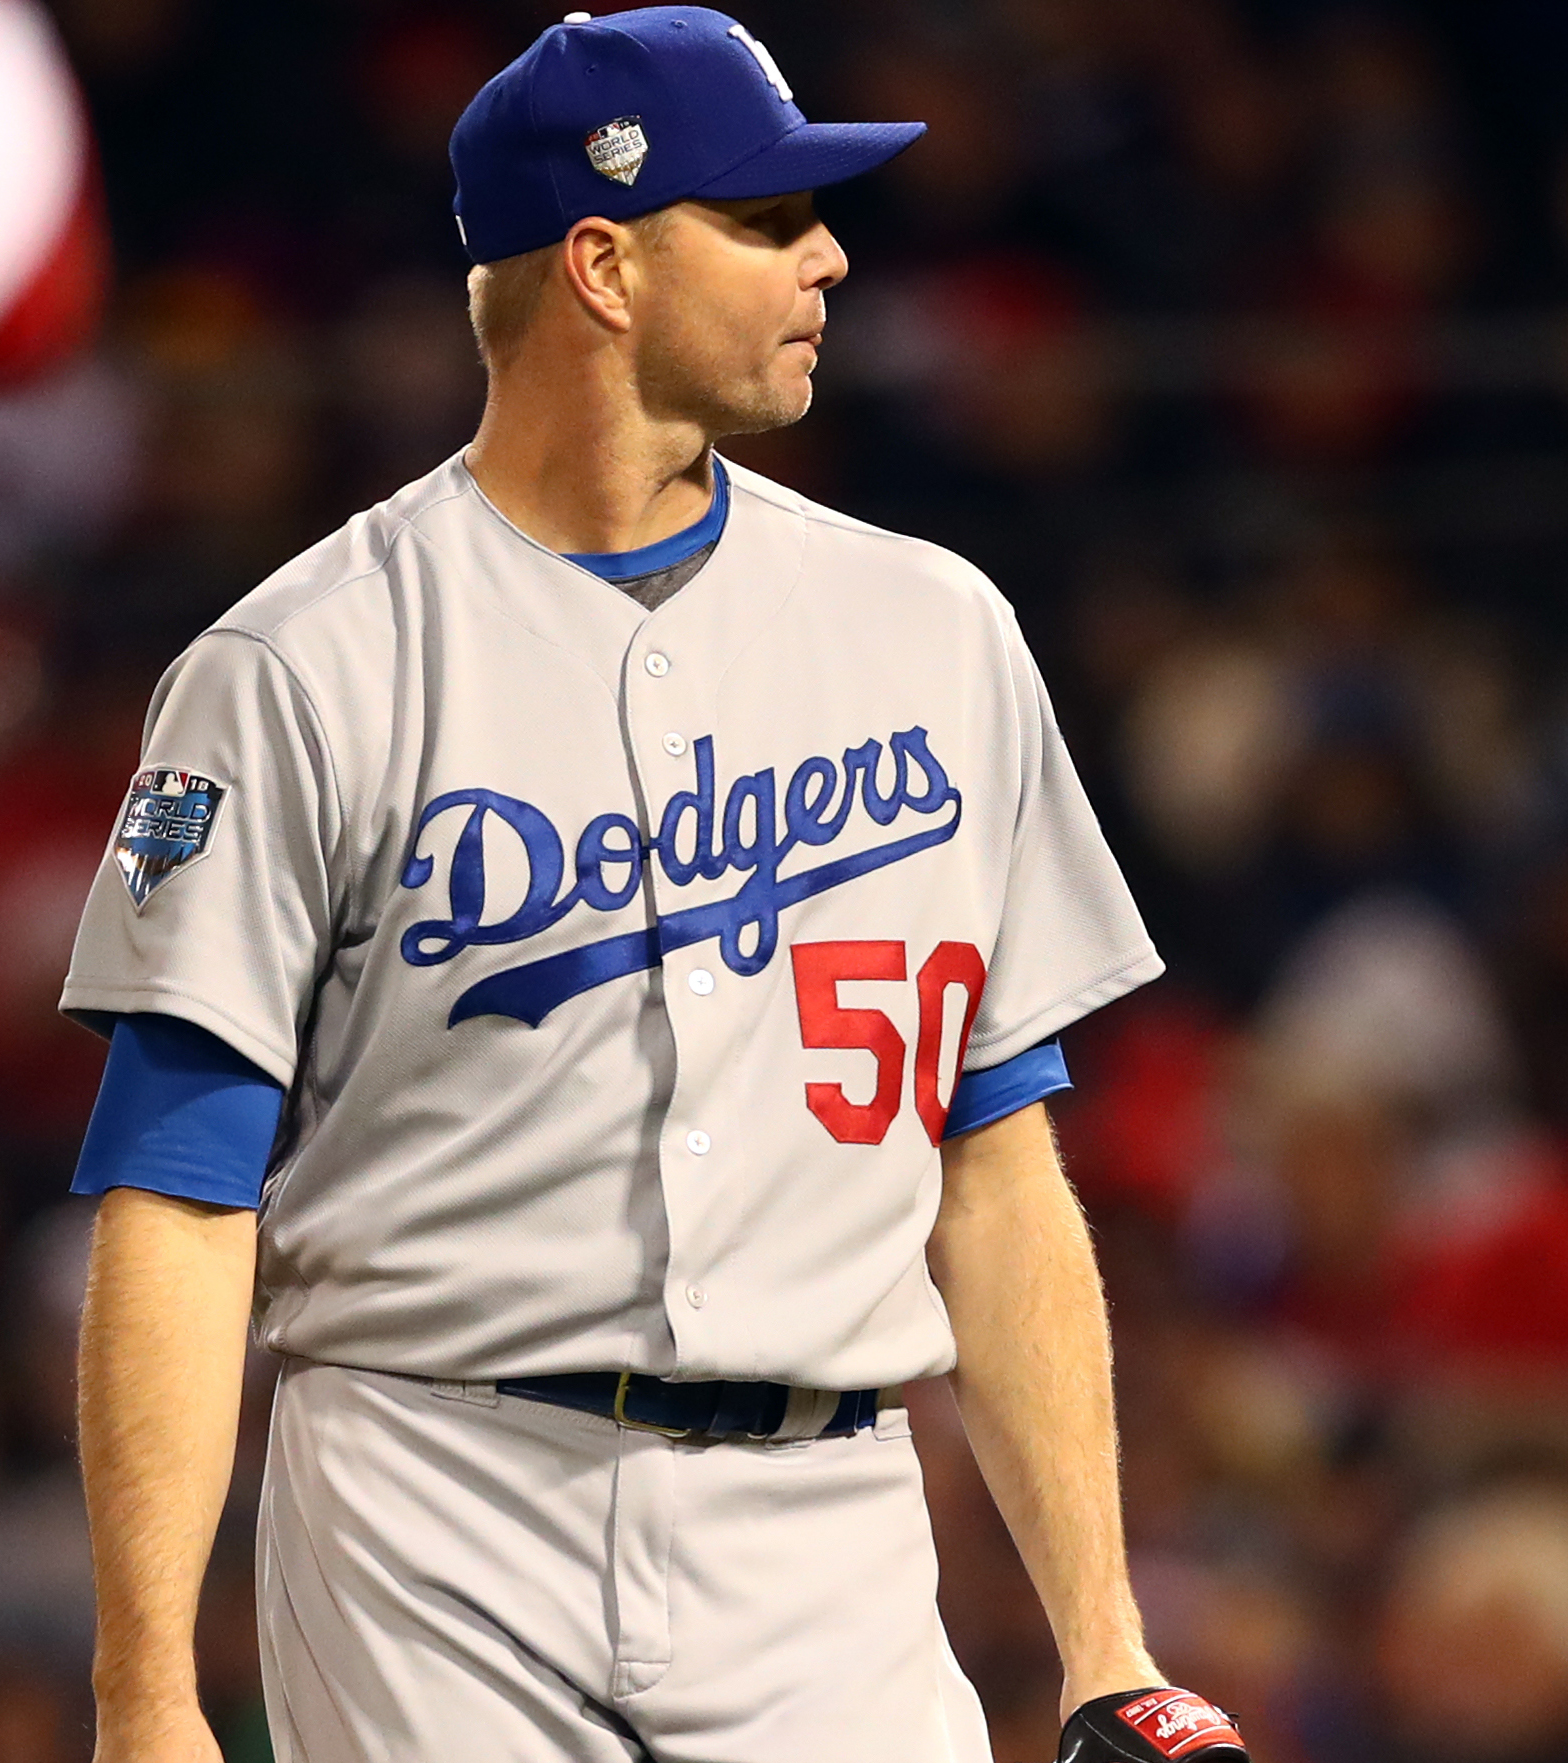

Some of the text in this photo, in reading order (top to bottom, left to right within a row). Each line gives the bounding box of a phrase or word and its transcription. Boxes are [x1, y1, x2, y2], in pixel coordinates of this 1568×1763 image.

[589, 129, 639, 155] WORLD
[593, 139, 642, 164] SERIES
[189, 777, 210, 792] 18
[128, 798, 211, 823] WORLD
[121, 816, 204, 845] SERIES
[400, 725, 962, 976] Dodgers
[789, 939, 986, 1148] 50
[1156, 1705, 1221, 1739] Rawlings
